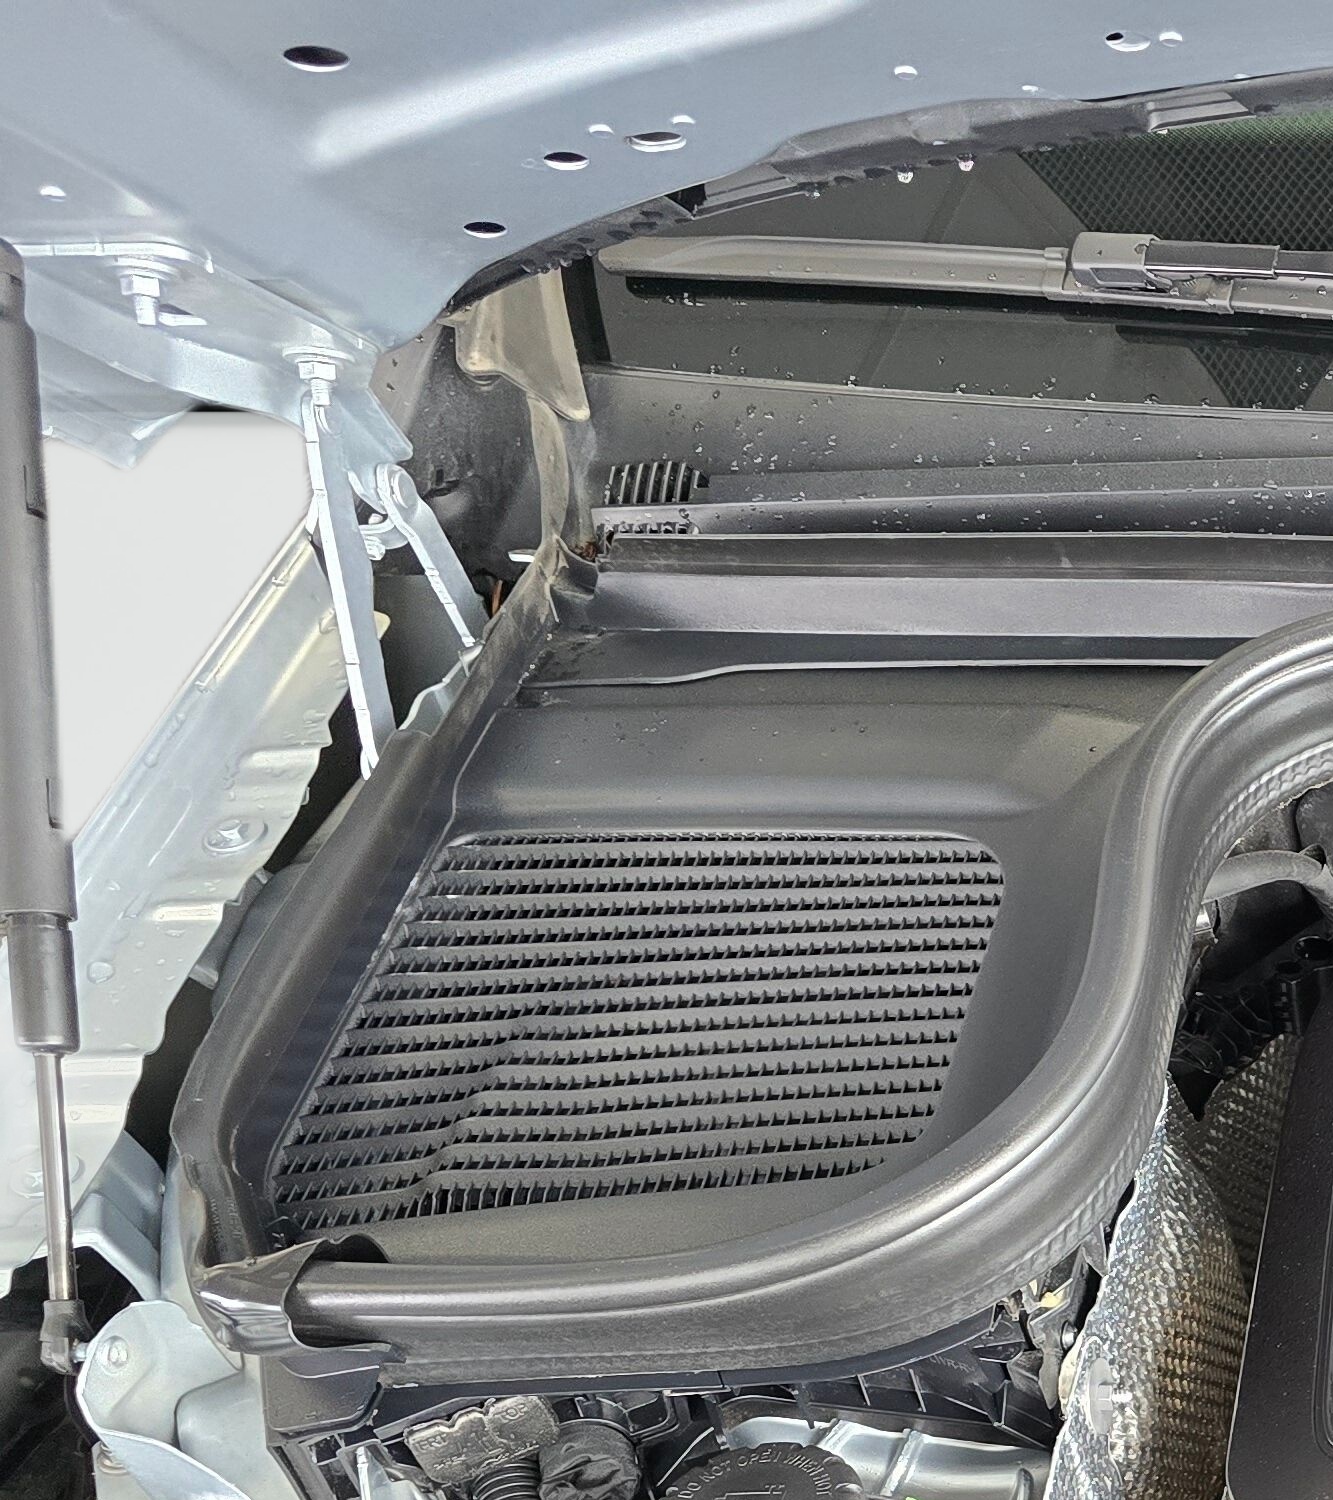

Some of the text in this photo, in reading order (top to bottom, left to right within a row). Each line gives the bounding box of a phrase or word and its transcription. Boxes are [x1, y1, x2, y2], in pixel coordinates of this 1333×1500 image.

[497, 1402, 528, 1422] TOP
[677, 1449, 833, 1499] DO NOT OPEN WHEN HOT
